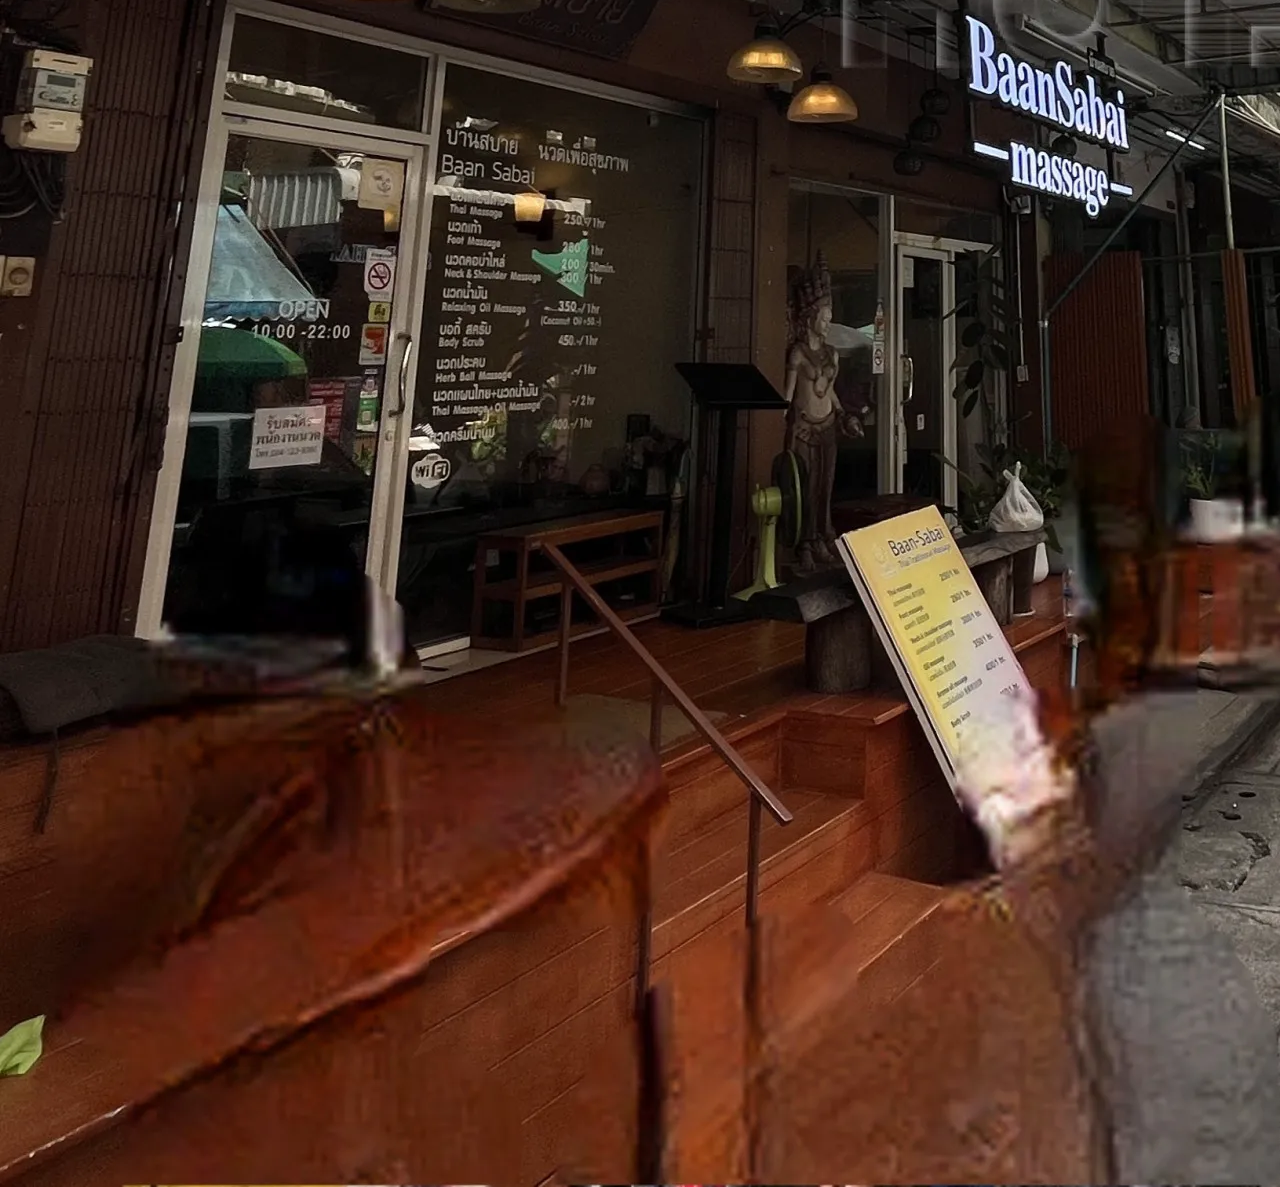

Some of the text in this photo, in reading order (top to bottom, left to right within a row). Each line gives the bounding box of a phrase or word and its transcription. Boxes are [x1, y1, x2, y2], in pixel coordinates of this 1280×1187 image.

[965, 15, 1130, 151] BaanSabai
[447, 121, 519, 155] บ้านสบาย
[441, 154, 535, 185] Baan Sabai
[1011, 141, 1110, 218] massage
[450, 204, 467, 215] Thai
[469, 208, 503, 219] Massage
[447, 235, 501, 249] Foot Massage
[444, 269, 465, 279] Neck
[473, 270, 507, 281] Shoulder
[510, 271, 541, 283] Massage
[279, 300, 330, 320] OPEN
[441, 302, 476, 314] Relaxing
[493, 303, 527, 316] Massage
[251, 324, 295, 340] 10:00
[438, 337, 485, 348] Body Scrub
[436, 355, 486, 370] นวดประคบ
[435, 370, 512, 383] Herb Ball Massage
[432, 405, 450, 416] Thai
[887, 523, 945, 556] Baan-Sabai
